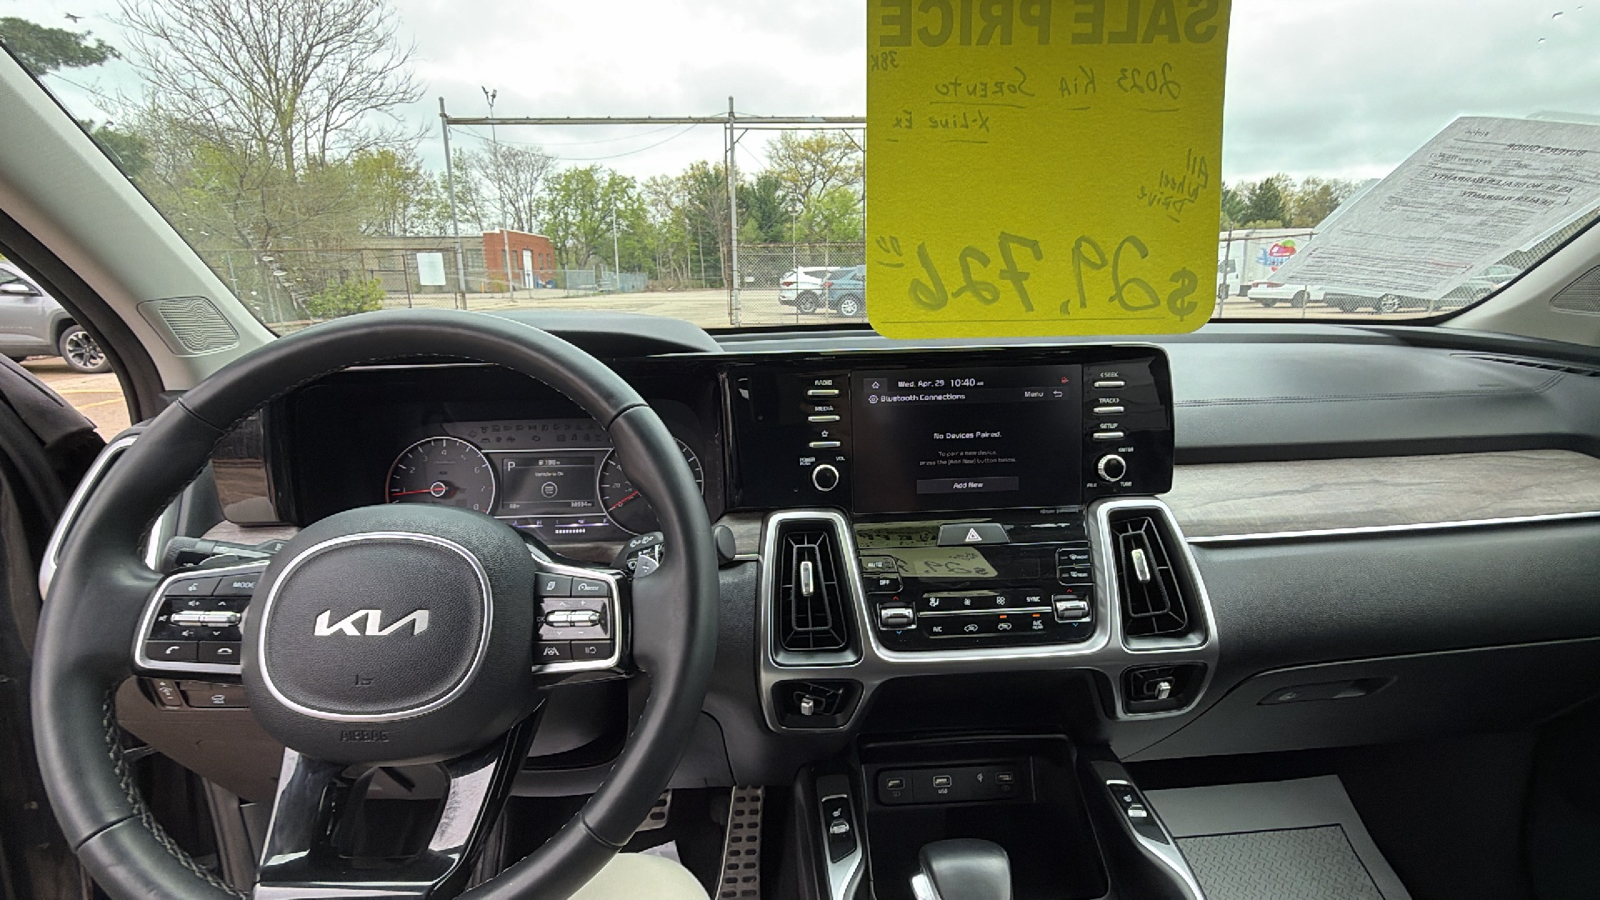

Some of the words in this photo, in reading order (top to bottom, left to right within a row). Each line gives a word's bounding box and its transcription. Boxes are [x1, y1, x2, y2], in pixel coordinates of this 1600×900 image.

[950, 378, 976, 387] 10:40
[880, 394, 918, 402] Bluetooth
[920, 393, 966, 402] Connections
[508, 461, 516, 472] P
